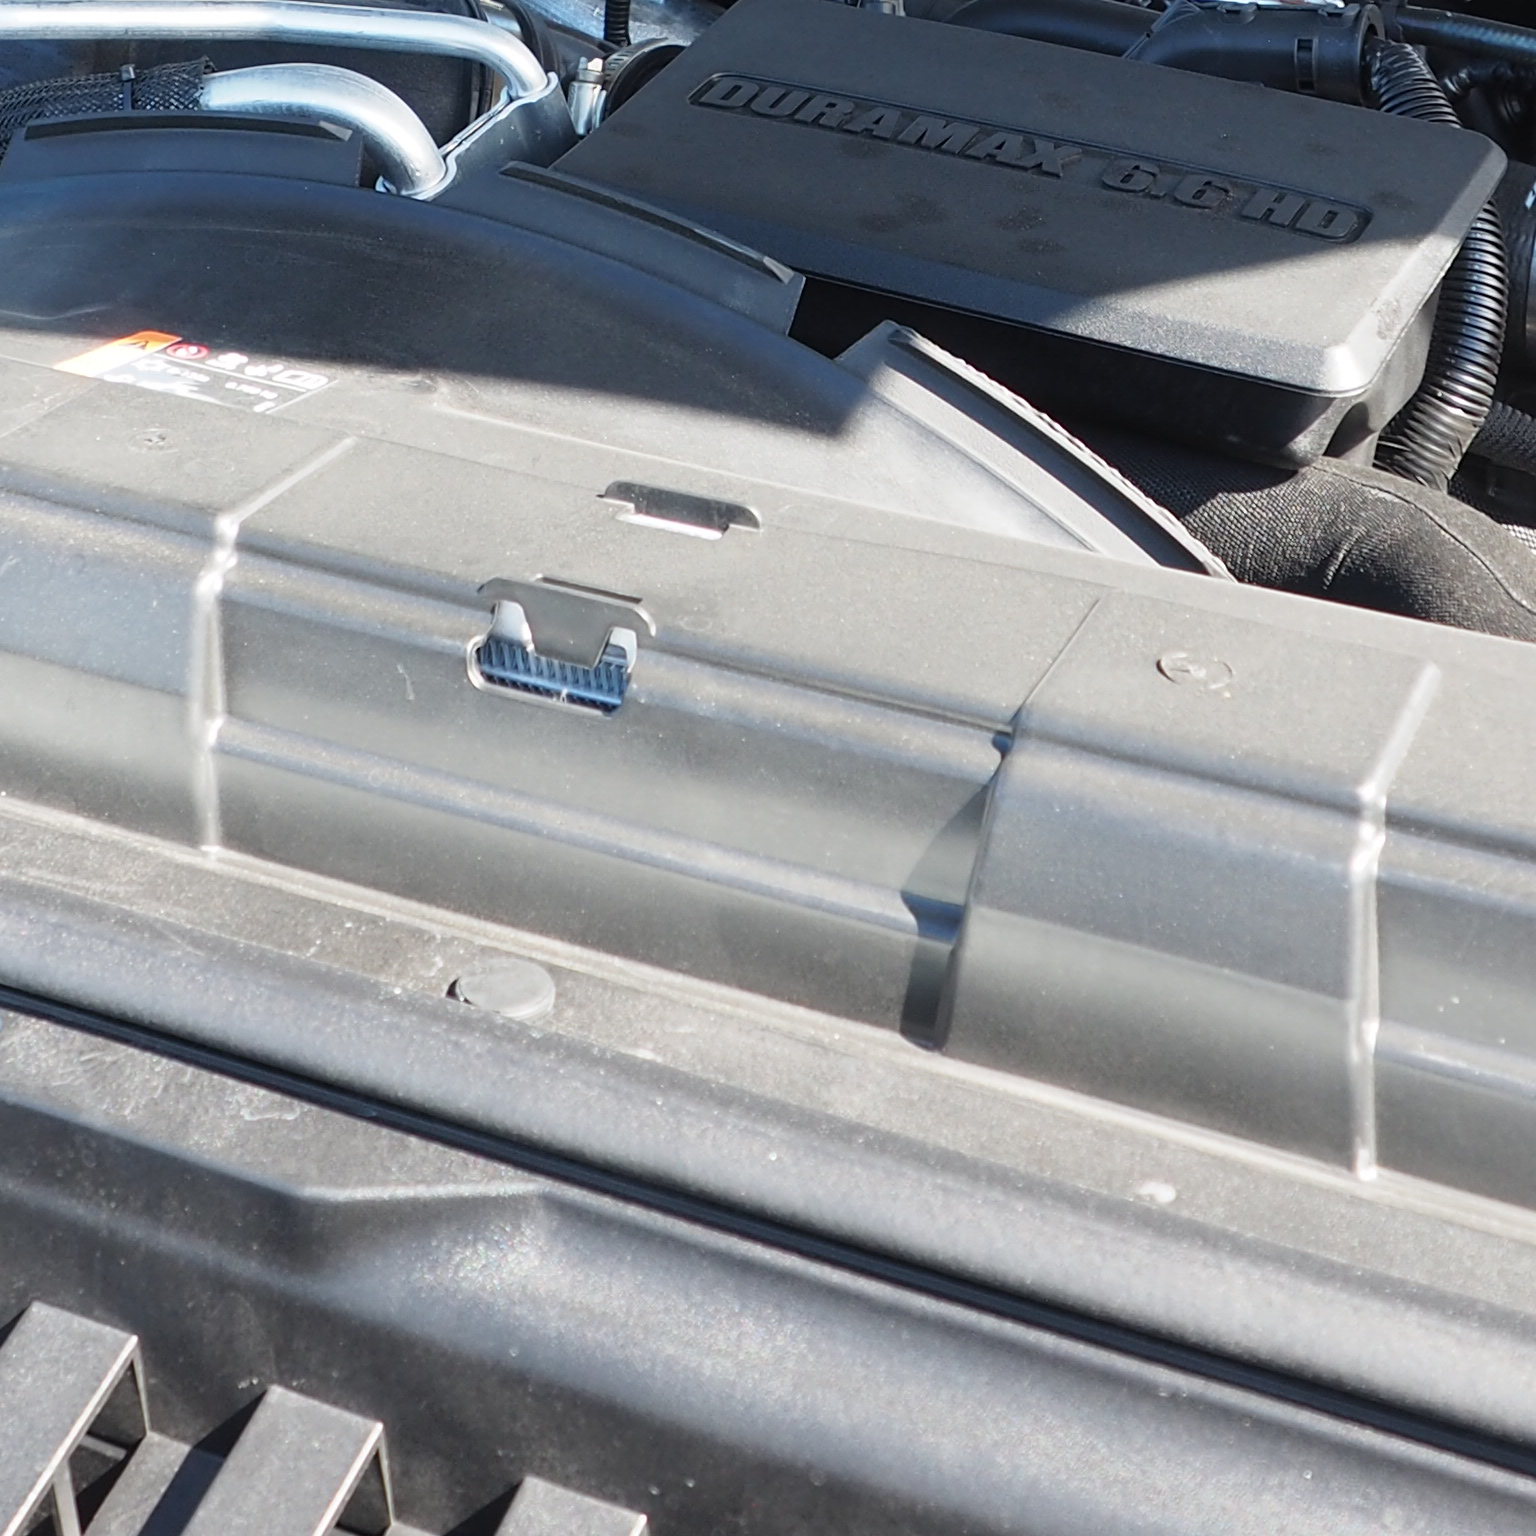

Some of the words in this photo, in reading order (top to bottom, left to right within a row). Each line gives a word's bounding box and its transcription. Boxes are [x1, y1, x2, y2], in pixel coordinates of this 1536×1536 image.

[698, 78, 1082, 178] DURAMAX
[1101, 158, 1231, 210] 6.6
[1238, 187, 1359, 241] HD
